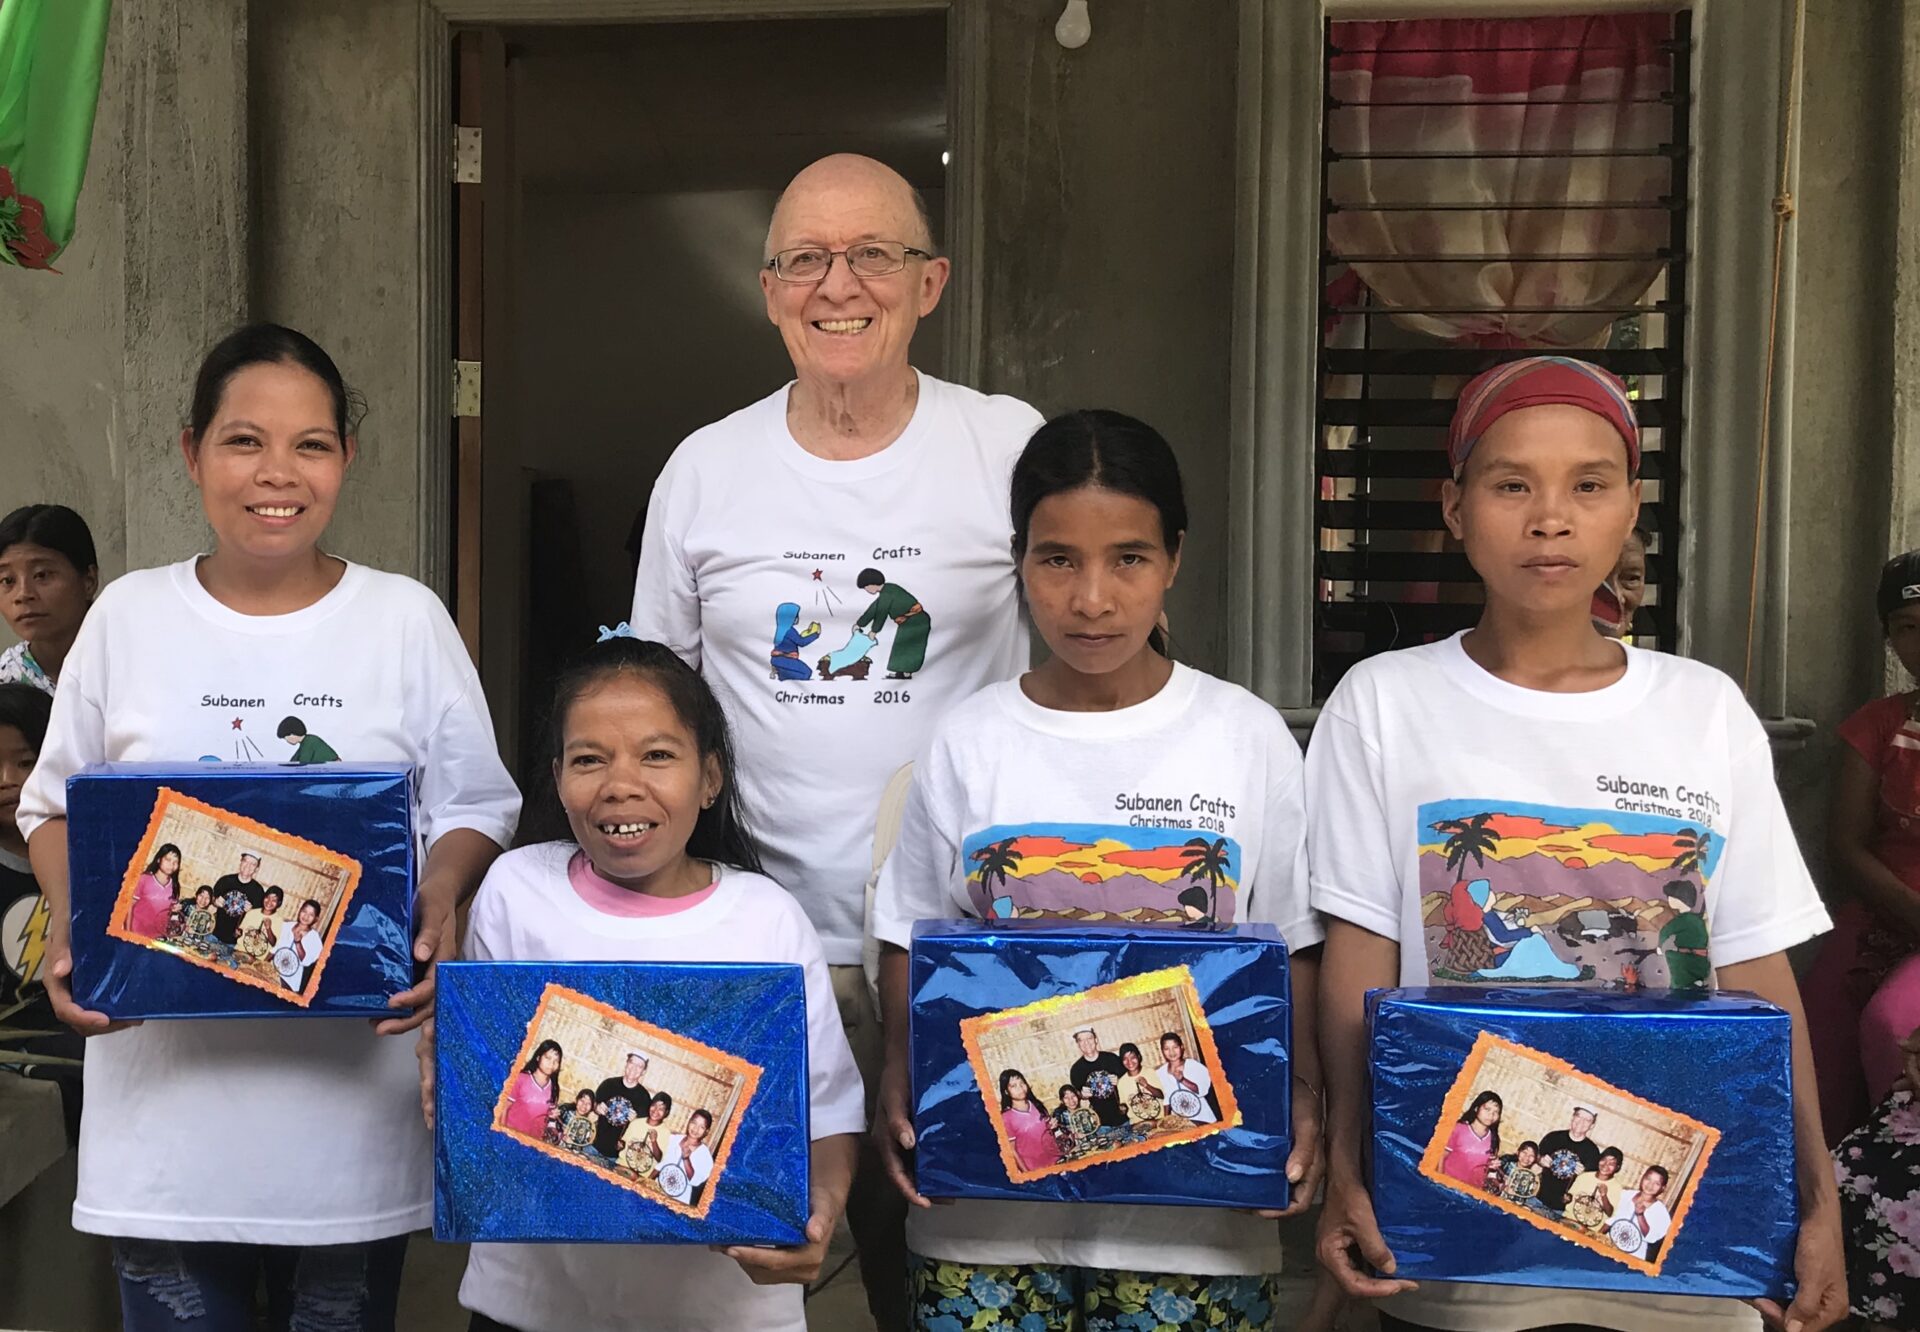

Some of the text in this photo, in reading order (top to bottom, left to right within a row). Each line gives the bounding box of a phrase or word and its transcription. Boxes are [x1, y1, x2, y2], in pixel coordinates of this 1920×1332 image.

[783, 546, 921, 561] Subanen Crafts
[201, 693, 343, 708] Subanen Crafts
[775, 691, 911, 705] Christmas 2016
[1596, 775, 1721, 815] Subanen Crafts
[1115, 792, 1236, 818] Subanen Crafts
[1615, 798, 1712, 827] Christmas 2018
[1129, 815, 1225, 833] Christmas 2018
